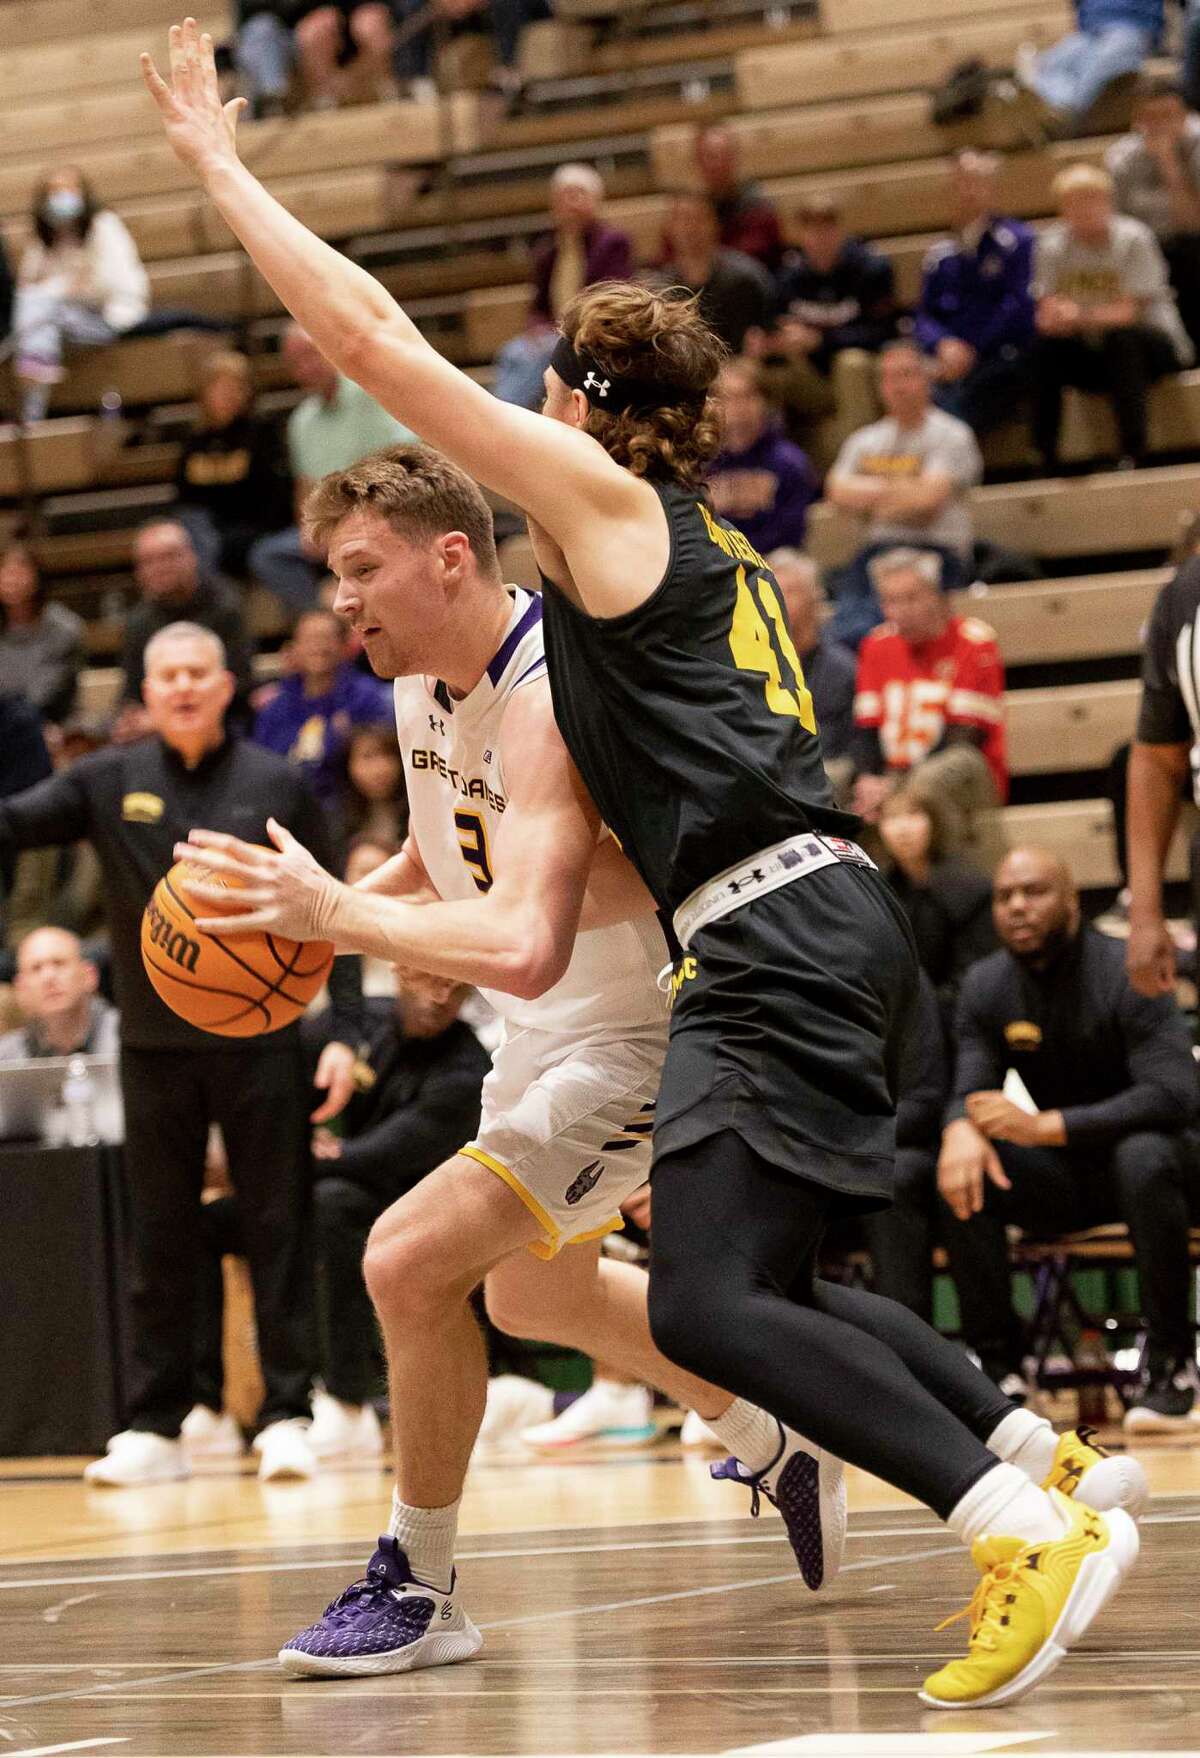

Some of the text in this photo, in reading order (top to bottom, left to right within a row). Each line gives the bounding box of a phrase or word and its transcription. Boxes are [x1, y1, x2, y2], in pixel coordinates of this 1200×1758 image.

[728, 563, 817, 735] 41
[882, 678, 948, 763] 15
[411, 748, 459, 789] GRET
[453, 807, 494, 896] 3
